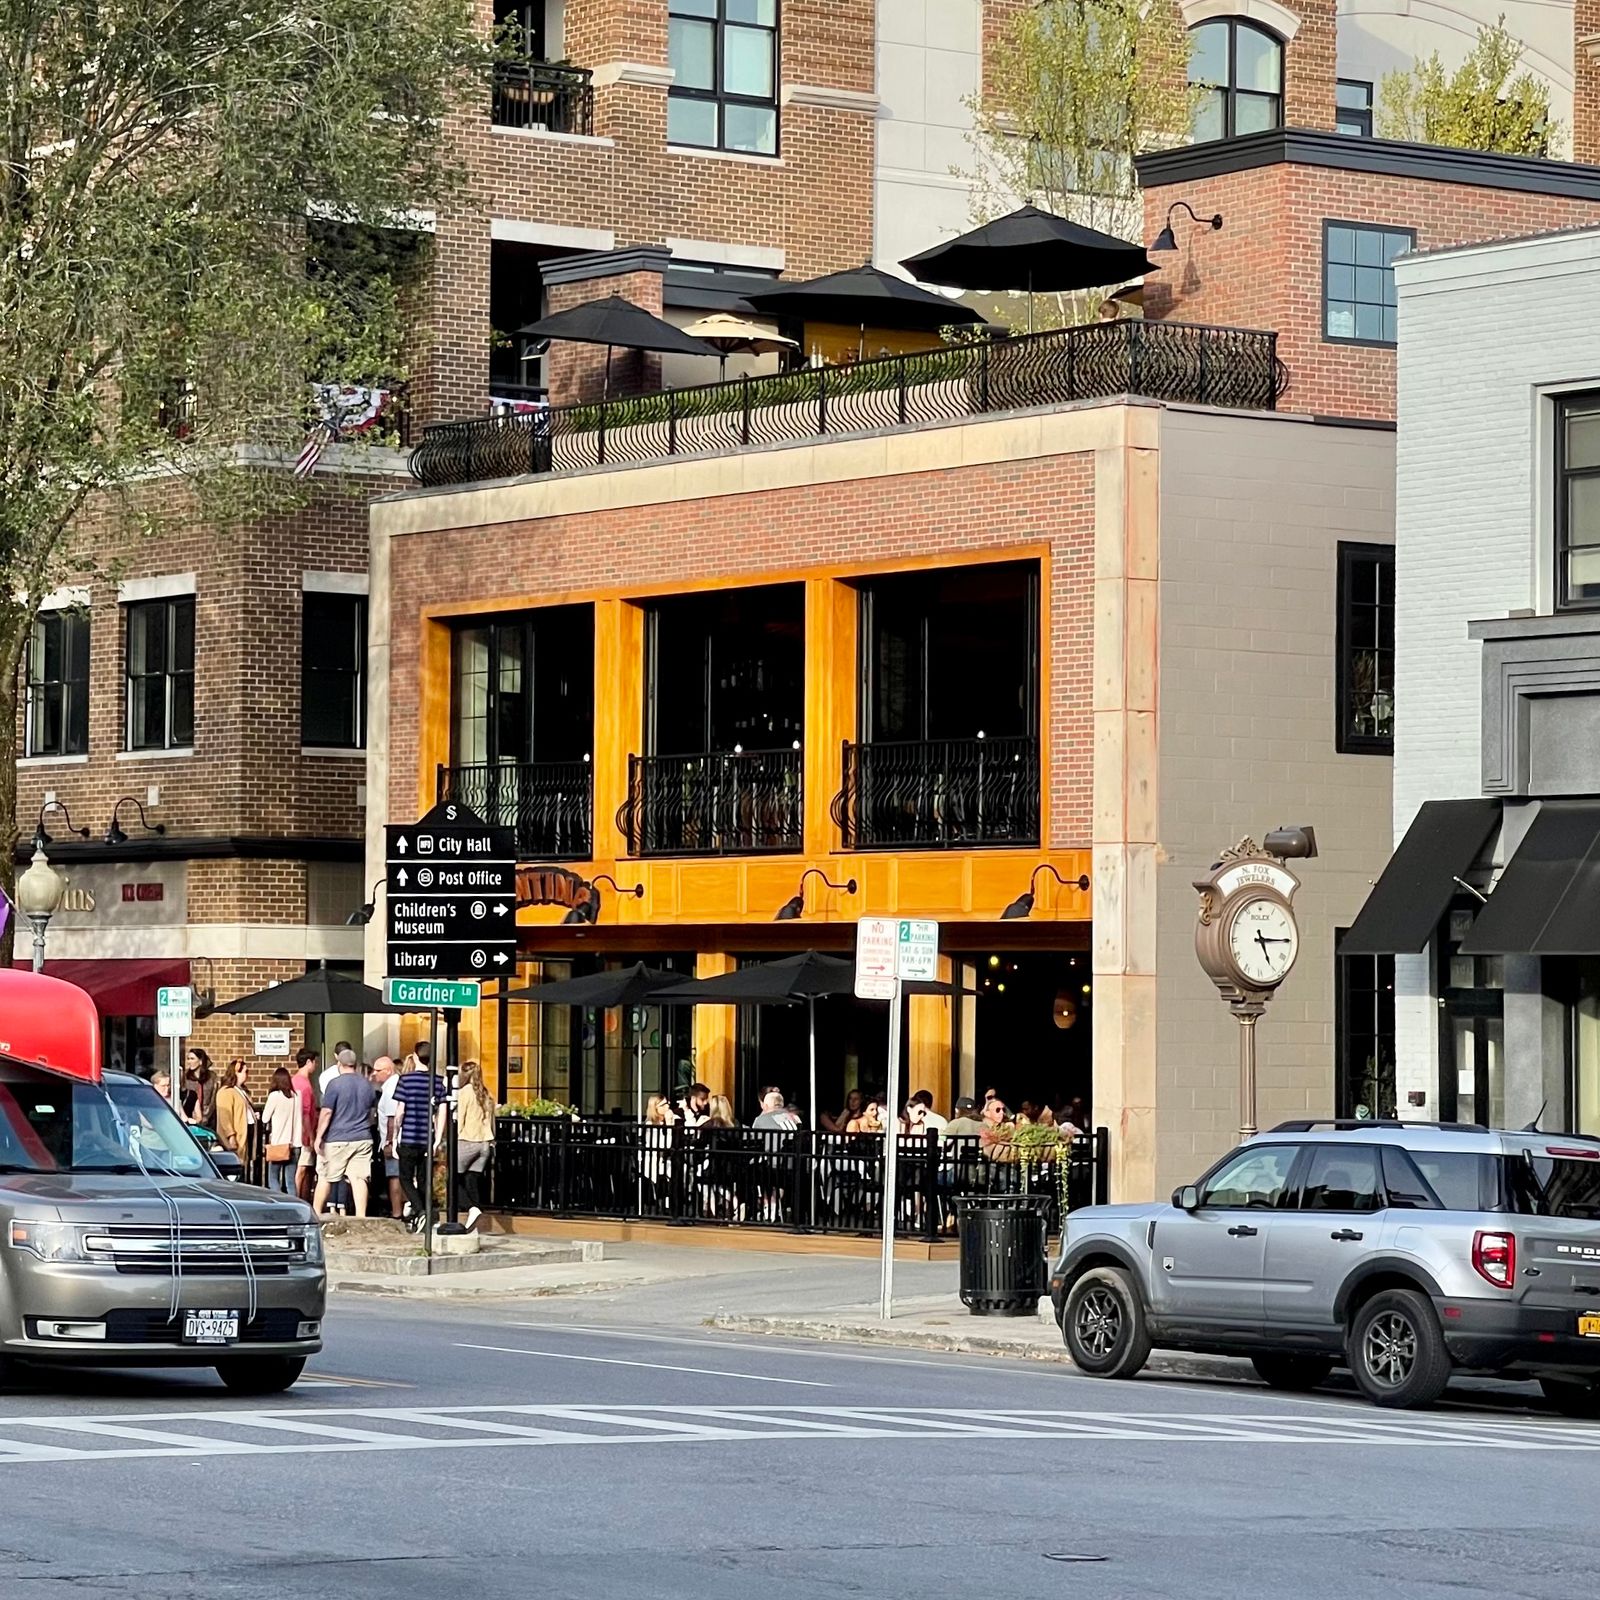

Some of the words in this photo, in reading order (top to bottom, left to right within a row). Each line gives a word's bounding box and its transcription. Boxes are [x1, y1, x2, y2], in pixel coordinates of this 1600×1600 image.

[439, 837, 462, 855] City
[467, 837, 491, 852] Hall
[1253, 865, 1269, 874] FOX
[439, 871, 464, 885] Post
[468, 871, 501, 885] Office
[1236, 874, 1275, 888] JEWELERS
[394, 903, 457, 917] Children's
[394, 921, 444, 934] Museum
[872, 924, 884, 934] NO
[900, 924, 909, 940] 2
[862, 936, 893, 946] PARKING
[911, 933, 935, 941] PARKING
[395, 953, 437, 969] Library
[160, 990, 167, 1004] 2
[398, 983, 455, 1002] Gardner
[461, 985, 472, 996] Ln
[1557, 1245, 1600, 1255] BRO
